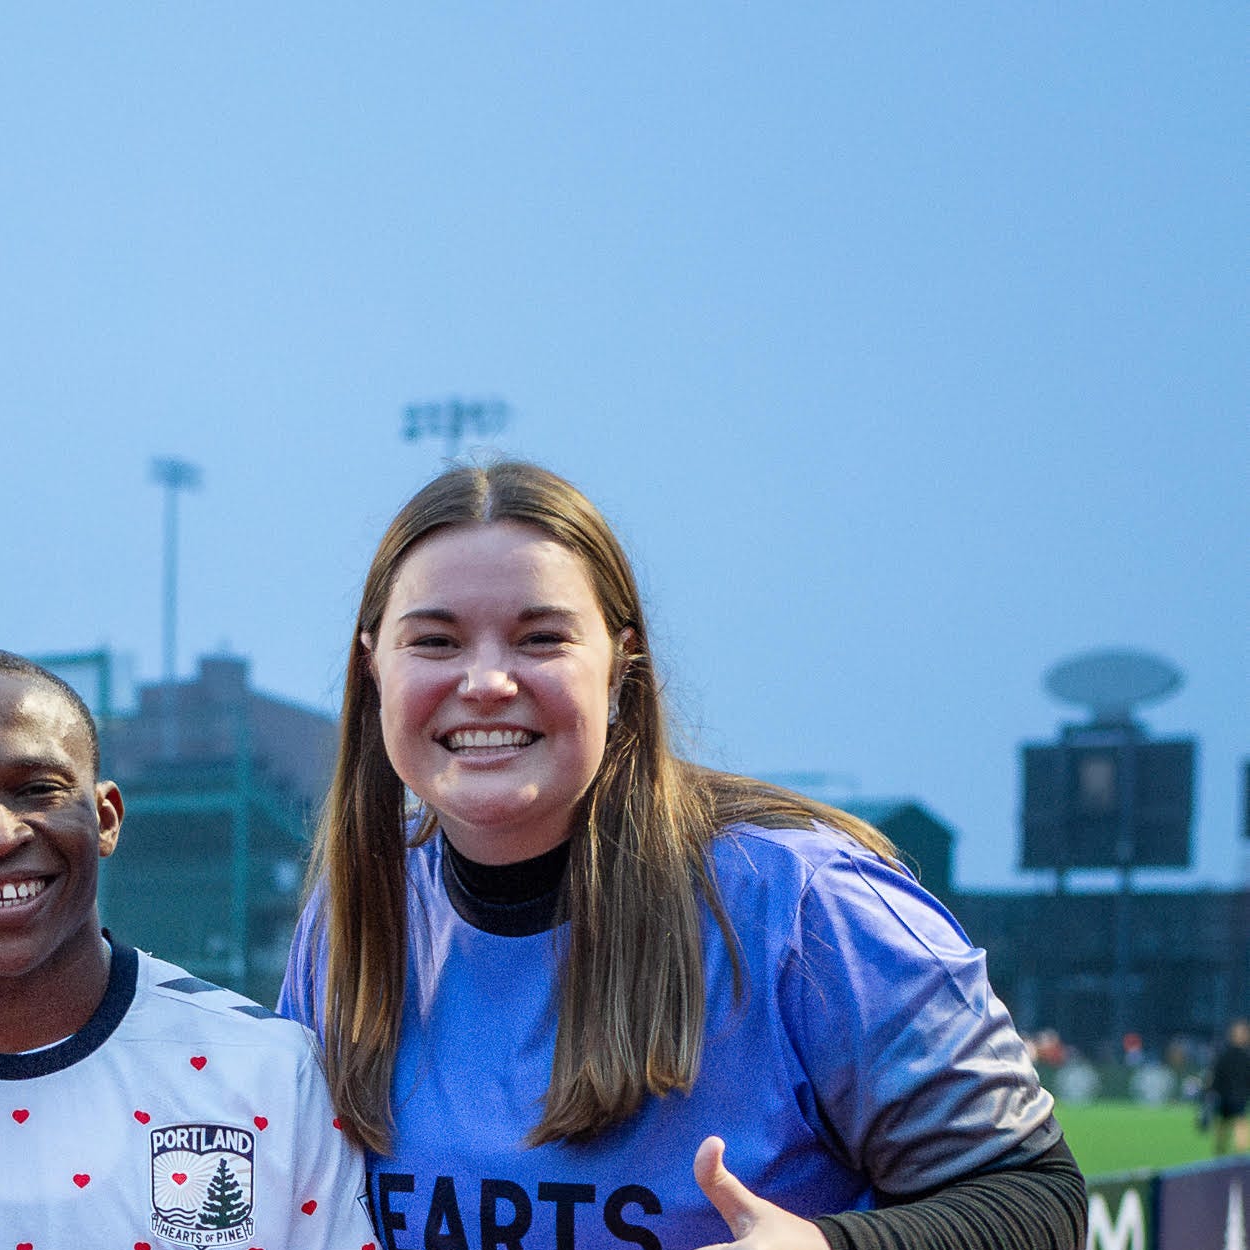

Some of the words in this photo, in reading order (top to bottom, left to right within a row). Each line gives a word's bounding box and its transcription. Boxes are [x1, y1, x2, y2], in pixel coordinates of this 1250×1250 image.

[152, 1127, 253, 1154] PORTLAND
[159, 1224, 202, 1243] HEARTS
[205, 1234, 215, 1242] OF
[216, 1227, 245, 1242] PINE
